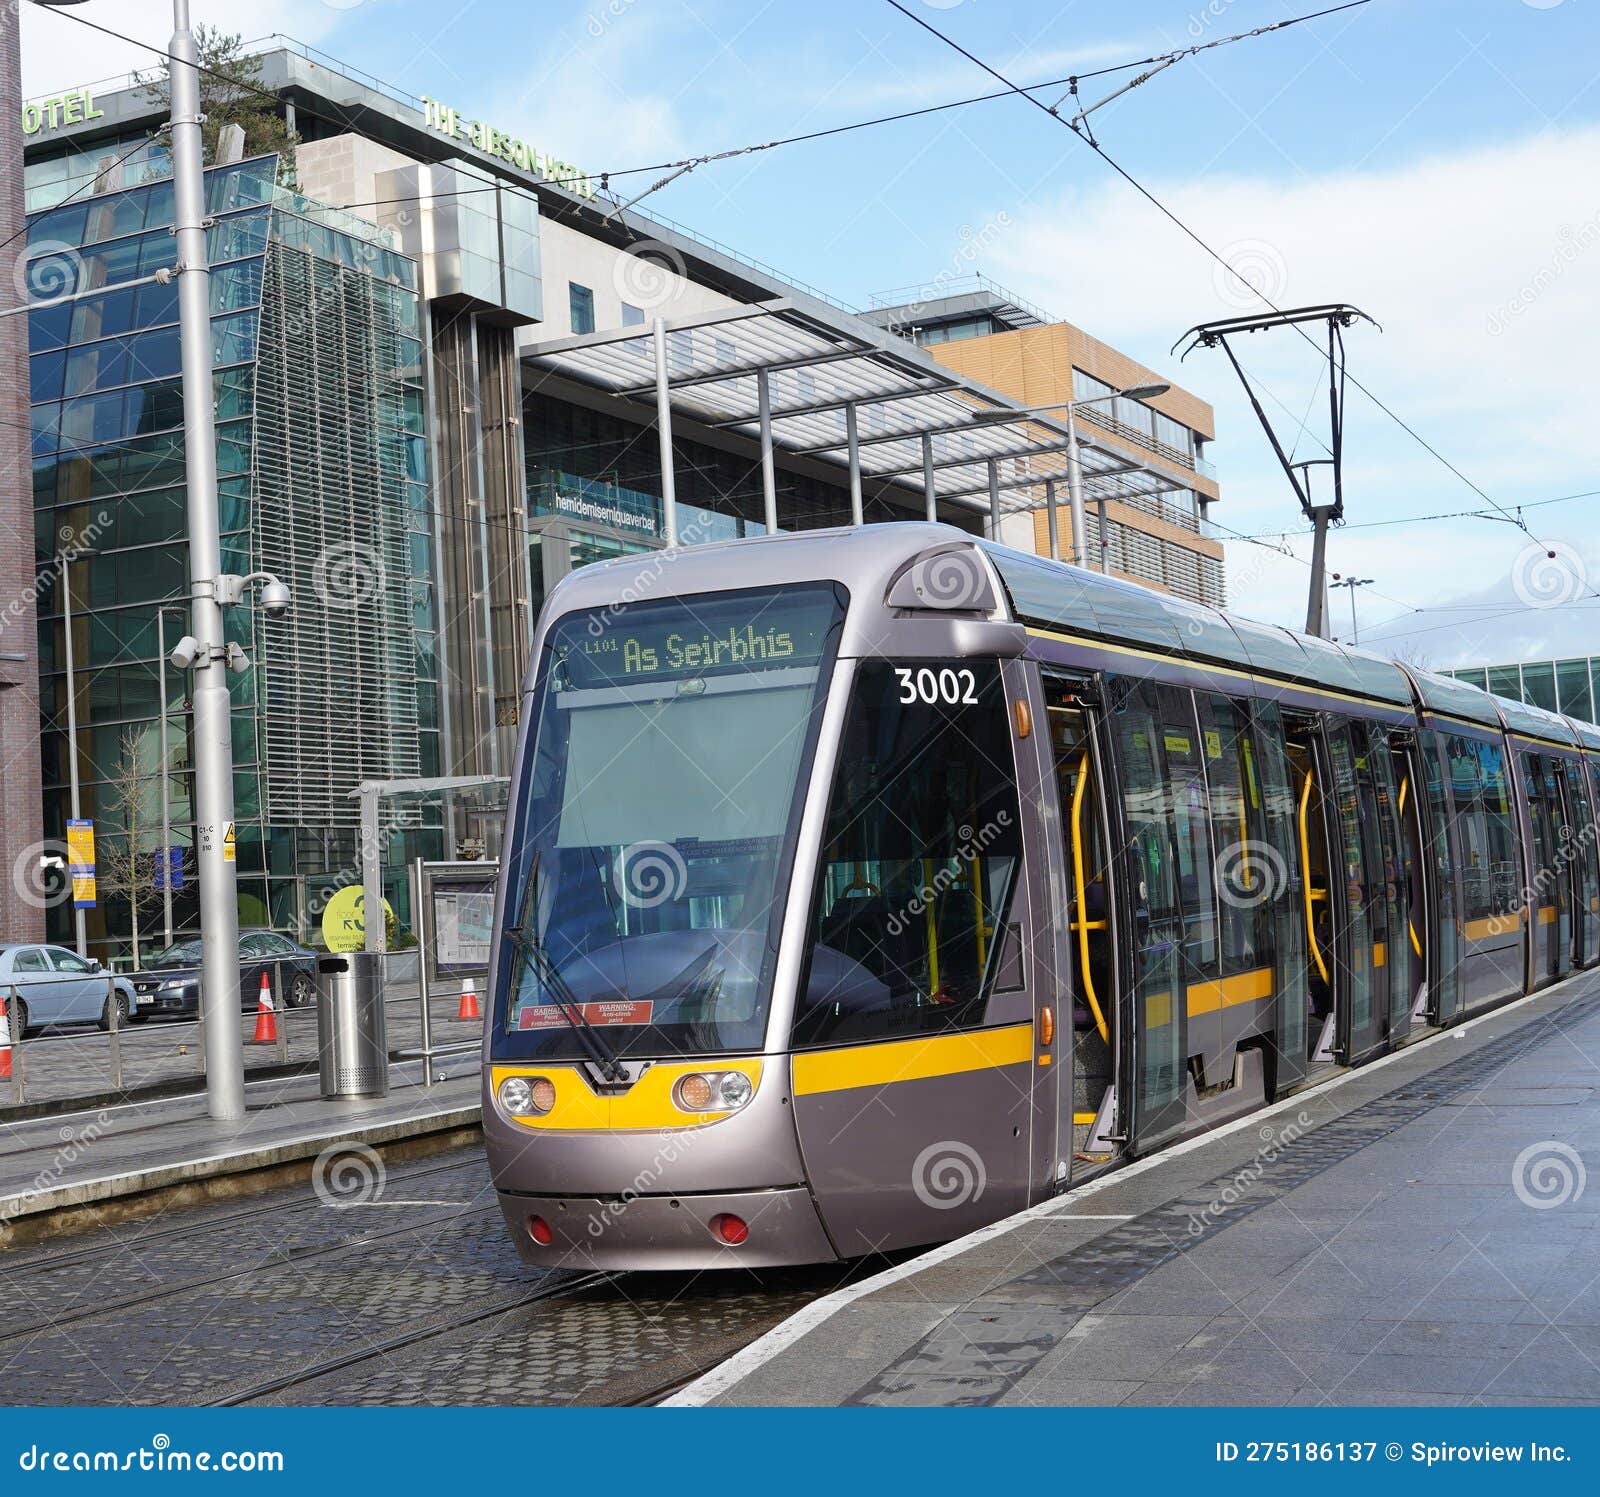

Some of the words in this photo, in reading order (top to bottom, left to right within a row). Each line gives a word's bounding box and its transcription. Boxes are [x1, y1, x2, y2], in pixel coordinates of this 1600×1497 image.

[420, 95, 463, 140] THE
[468, 119, 537, 174] GIBSON
[542, 153, 597, 203] HOTEL
[555, 492, 656, 530] hemidemisemiquaverbar
[624, 638, 659, 672] As
[666, 625, 794, 668] Seirbhís
[895, 668, 978, 704] 3002
[599, 1003, 636, 1012] WARNING:
